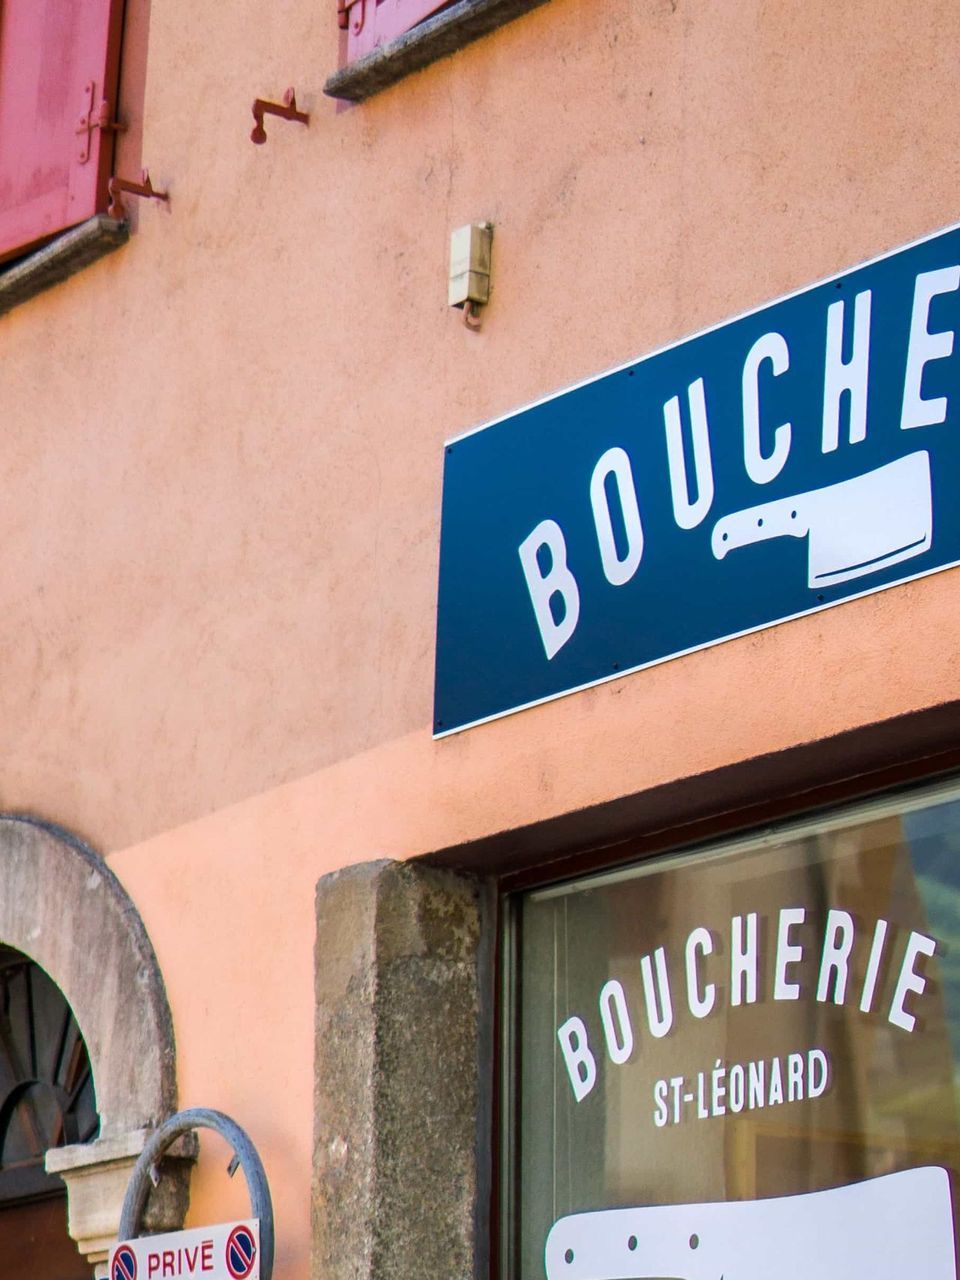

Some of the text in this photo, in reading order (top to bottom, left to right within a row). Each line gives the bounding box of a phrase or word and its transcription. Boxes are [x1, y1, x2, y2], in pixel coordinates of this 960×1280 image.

[557, 908, 936, 1103] BOUCHERIE
[653, 1049, 828, 1128] ST-LÉONARD
[148, 1239, 214, 1280] PRIVÉ
